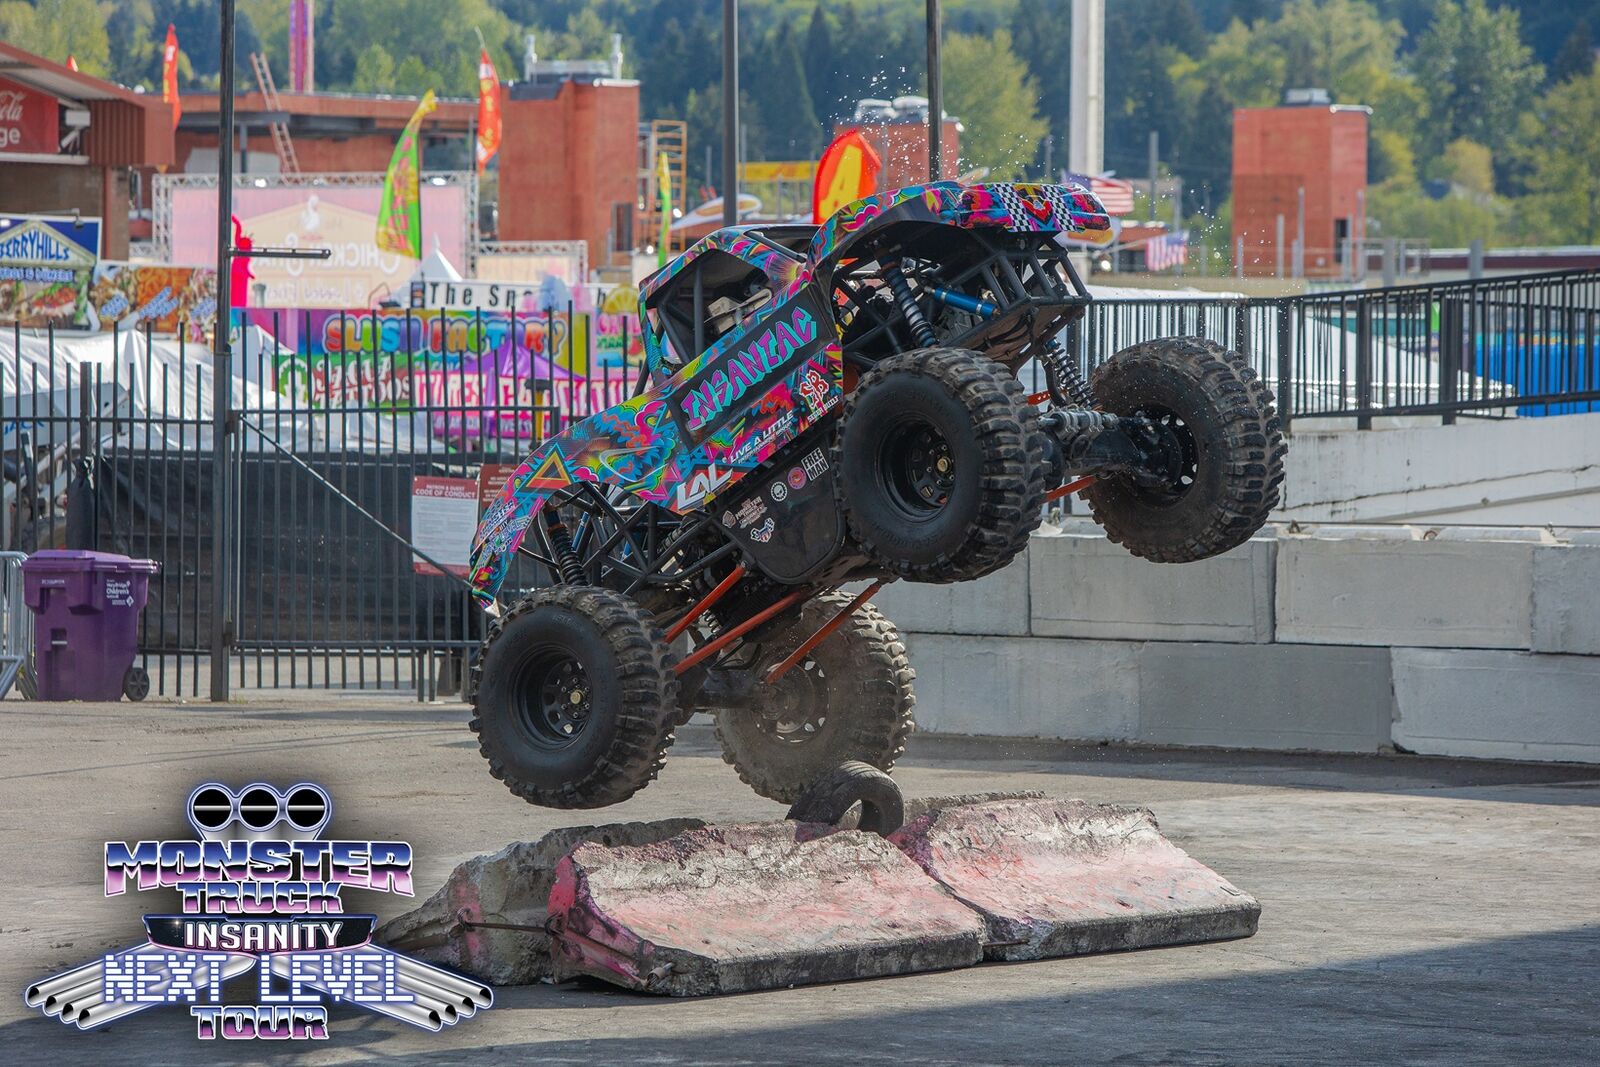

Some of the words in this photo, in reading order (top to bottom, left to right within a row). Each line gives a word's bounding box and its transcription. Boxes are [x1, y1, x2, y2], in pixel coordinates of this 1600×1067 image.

[429, 283, 472, 305] The
[324, 316, 422, 353] SLUSH
[429, 317, 567, 355] FACTORY
[680, 306, 816, 432] INSANIAC
[730, 442, 752, 464] LIVE
[754, 435, 762, 445] A
[763, 410, 794, 439] LITTLE
[803, 448, 824, 469] FREE
[808, 459, 829, 480] MAN
[415, 488, 433, 496] CODE
[444, 490, 475, 498] CONDUCT
